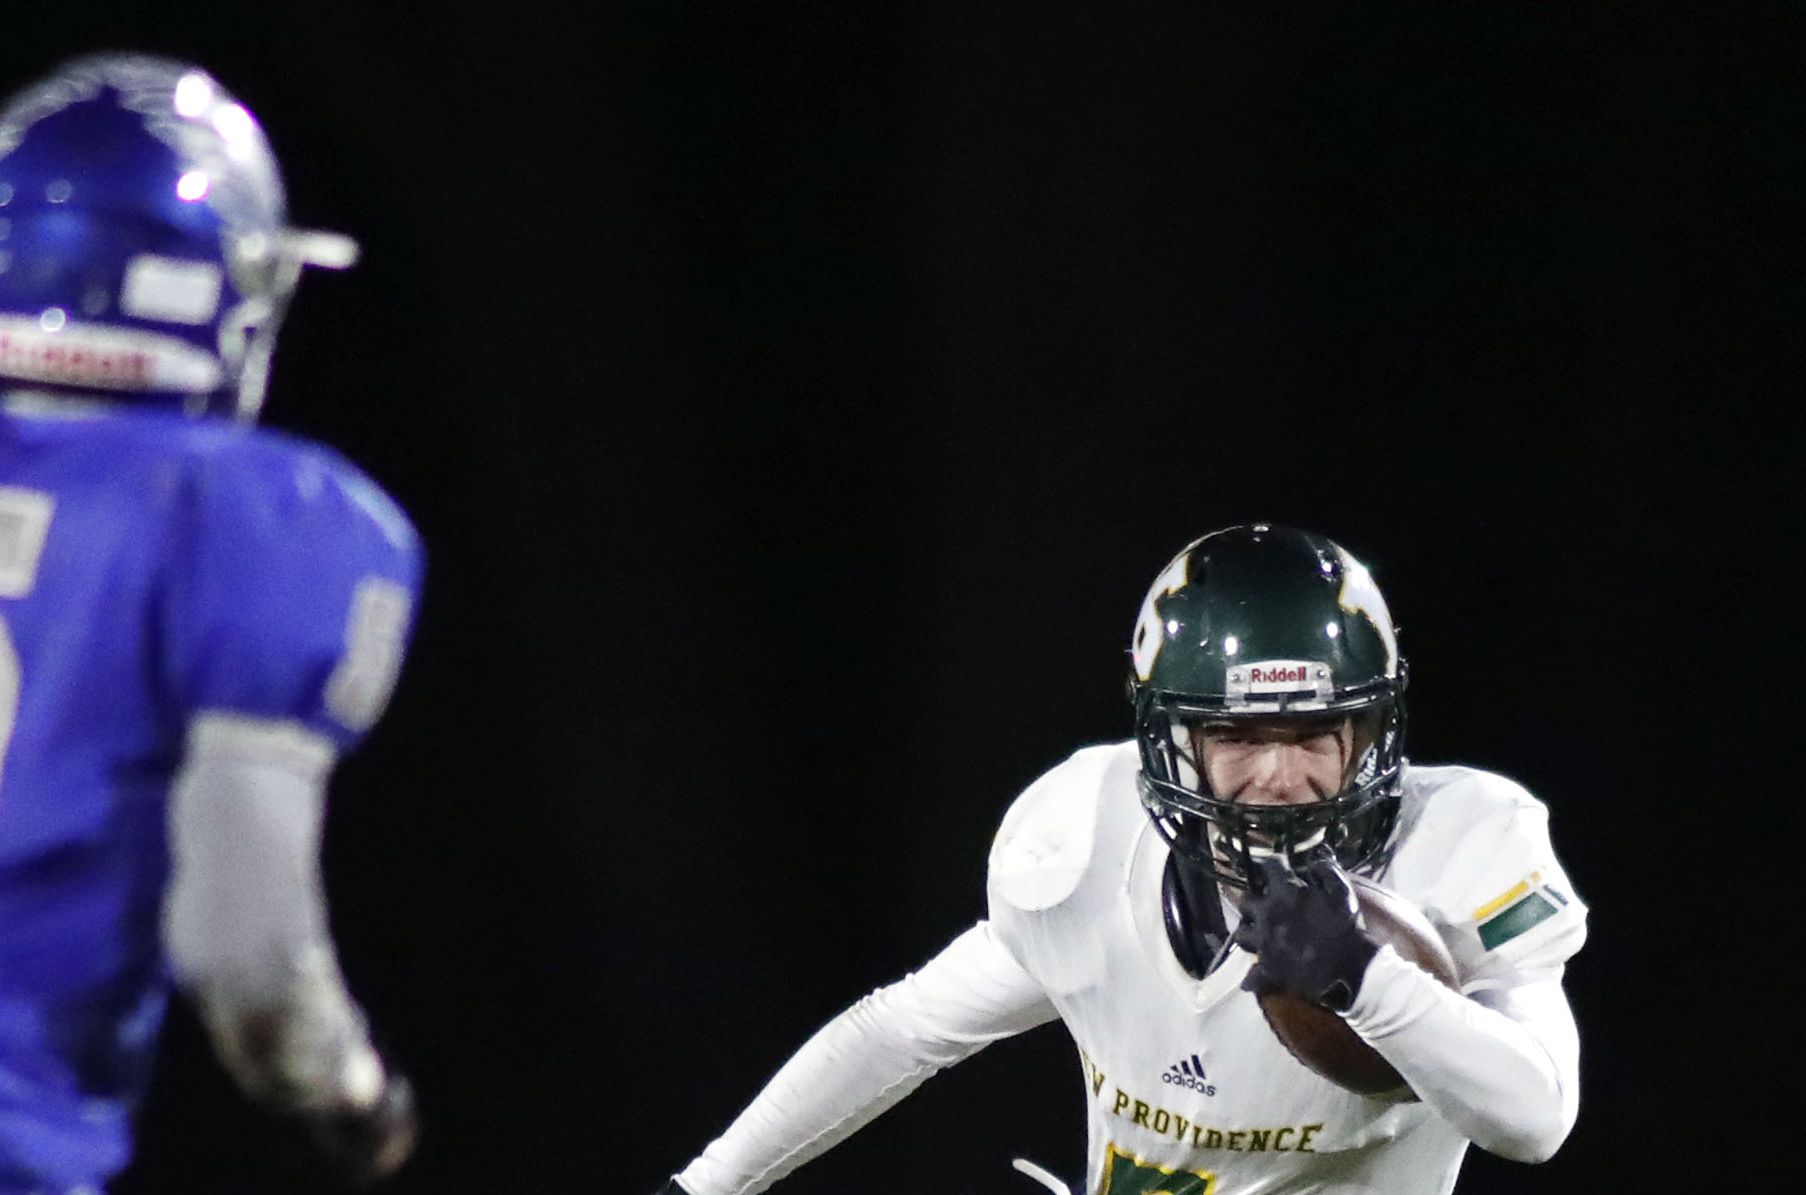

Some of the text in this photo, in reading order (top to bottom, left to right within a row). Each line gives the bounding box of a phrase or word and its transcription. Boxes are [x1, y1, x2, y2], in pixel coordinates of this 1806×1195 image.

[1251, 666, 1307, 682] Riddell
[1162, 1072, 1216, 1097] adidas
[1112, 1087, 1324, 1153] PROVIDENCE
